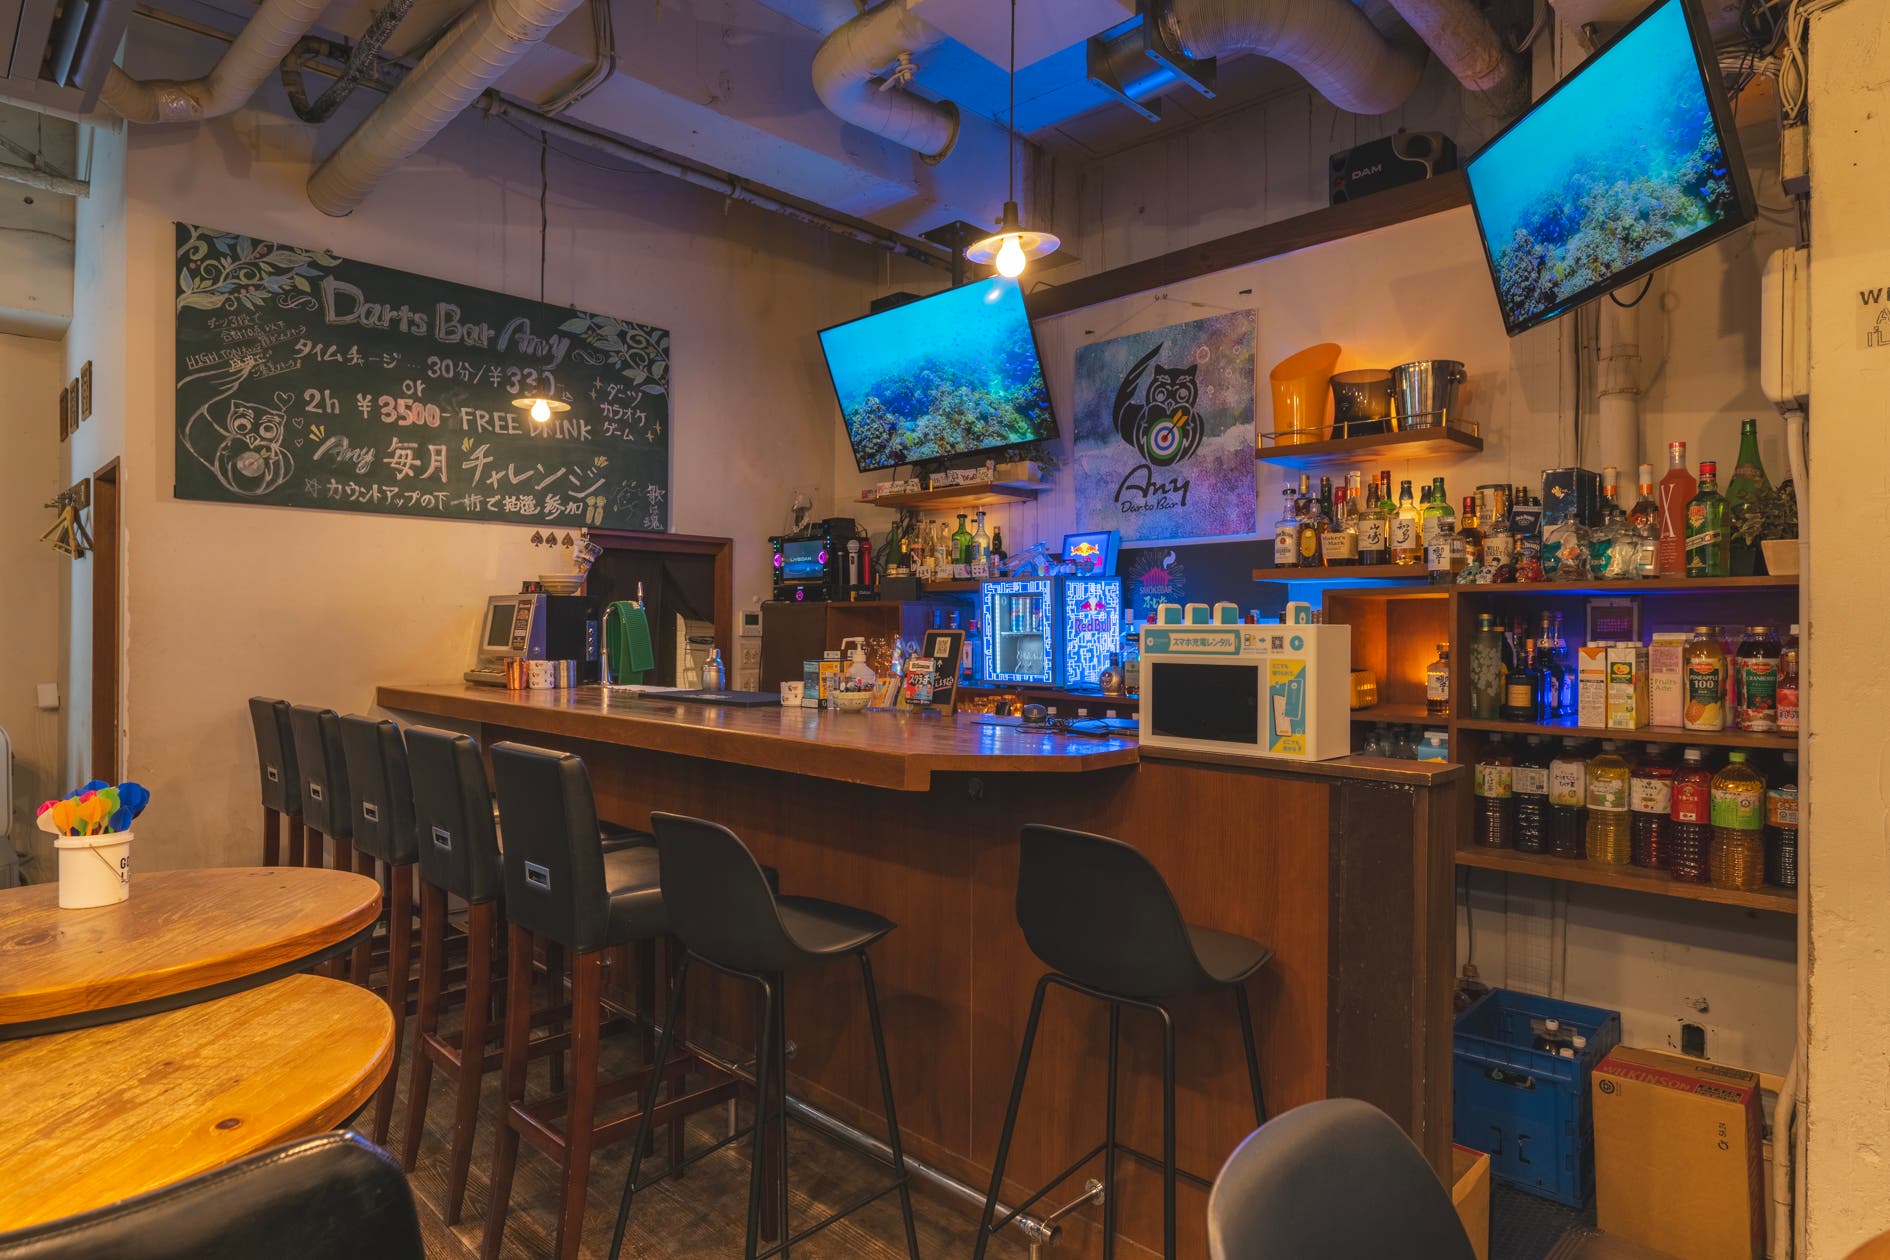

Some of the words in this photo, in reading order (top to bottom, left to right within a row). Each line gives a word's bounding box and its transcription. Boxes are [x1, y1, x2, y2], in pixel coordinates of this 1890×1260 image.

[1352, 163, 1382, 180] DAM
[321, 274, 429, 336] Darts
[435, 302, 496, 349] Bar
[498, 316, 571, 371] Any
[186, 351, 218, 370] HIGH
[294, 338, 401, 369] タイムチャージ
[402, 379, 426, 397] or
[607, 384, 642, 407] ダーツ
[303, 388, 341, 414] 2h
[461, 407, 523, 435] FREE
[600, 402, 647, 428] カラオケ
[603, 421, 634, 440] ゲーム
[313, 435, 376, 474] Any
[383, 437, 449, 483] 毎月
[1114, 463, 1190, 507] Any
[1156, 496, 1178, 510] Bar
[1075, 619, 1093, 632] Red
[1094, 618, 1111, 632] Bull
[1172, 637, 1233, 648] スマホ充電レンタル
[1693, 680, 1714, 689] 100
[1603, 1065, 1690, 1091] WILKINSON
